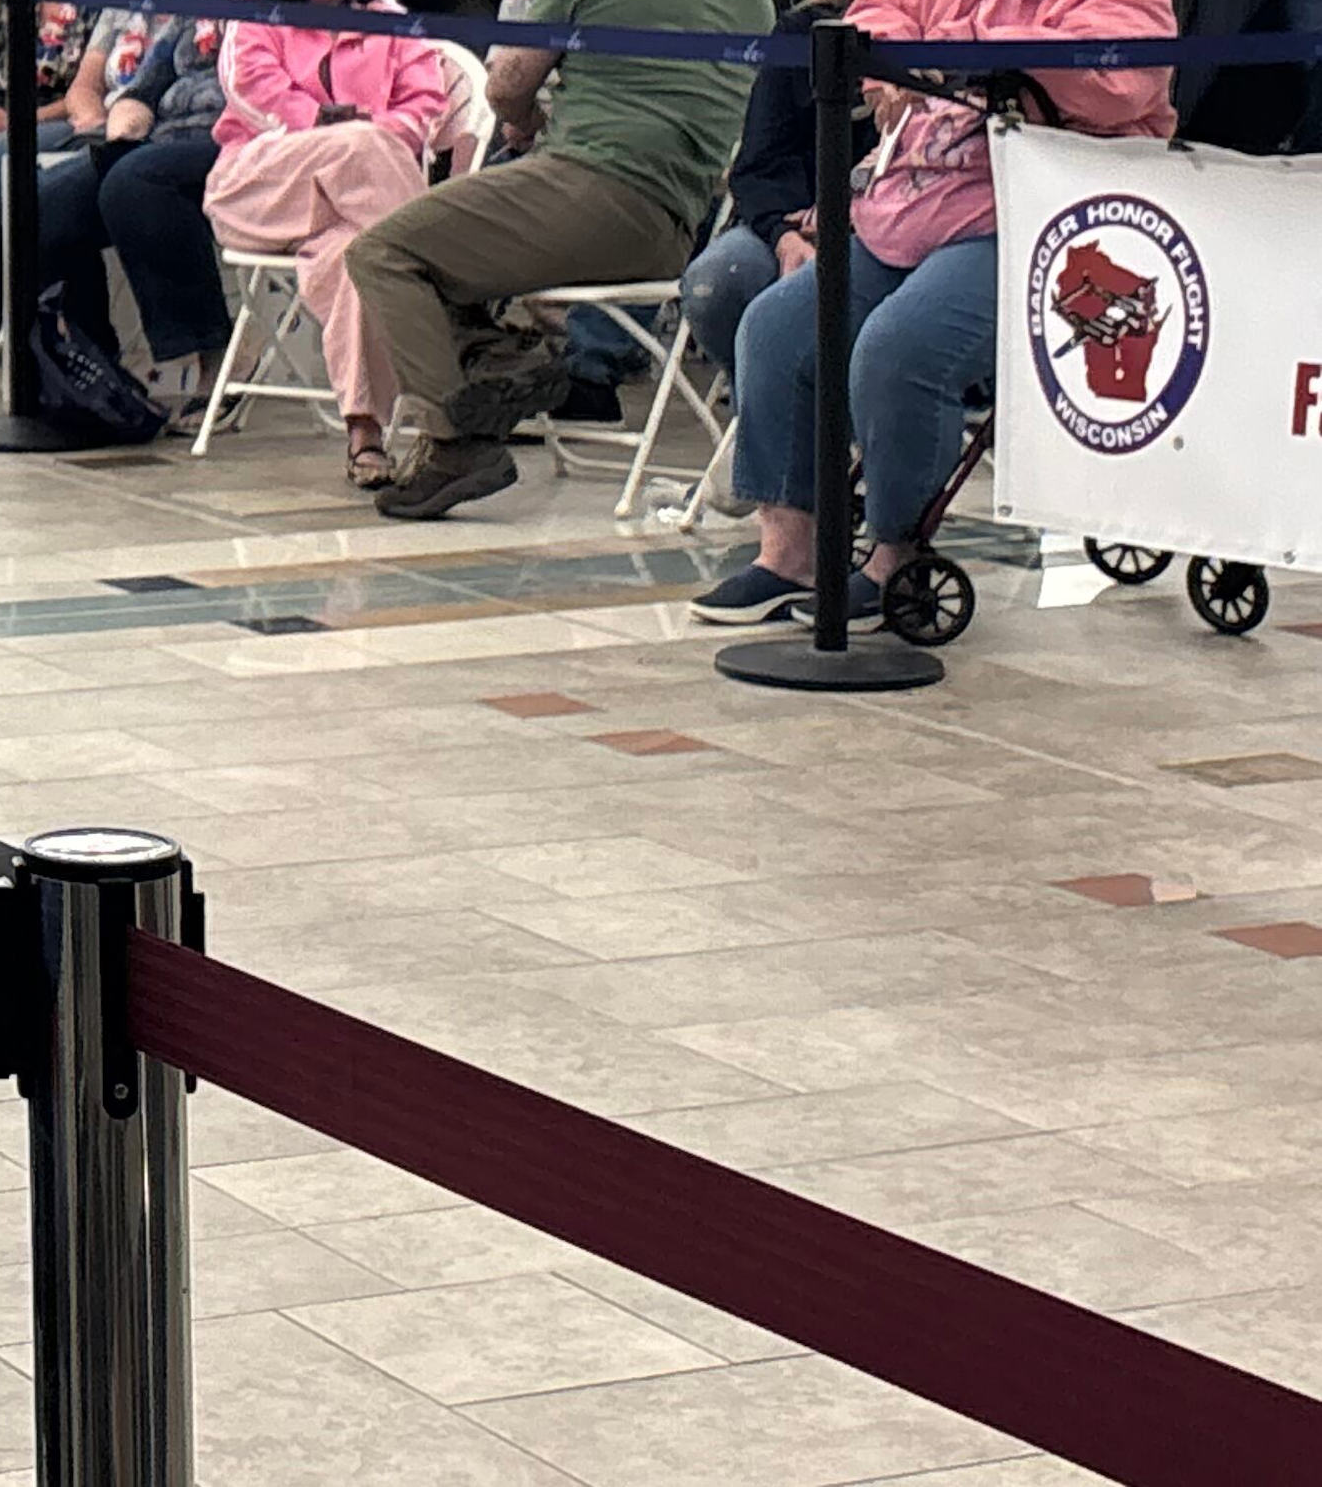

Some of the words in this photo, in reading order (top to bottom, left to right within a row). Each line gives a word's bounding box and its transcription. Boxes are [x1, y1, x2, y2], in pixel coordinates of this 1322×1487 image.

[1029, 213, 1081, 337] BADGER
[1085, 200, 1176, 246] HONOR
[1170, 243, 1205, 351] FLIGHT
[1054, 391, 1169, 448] WISCONSIN
[1290, 362, 1322, 436] F
